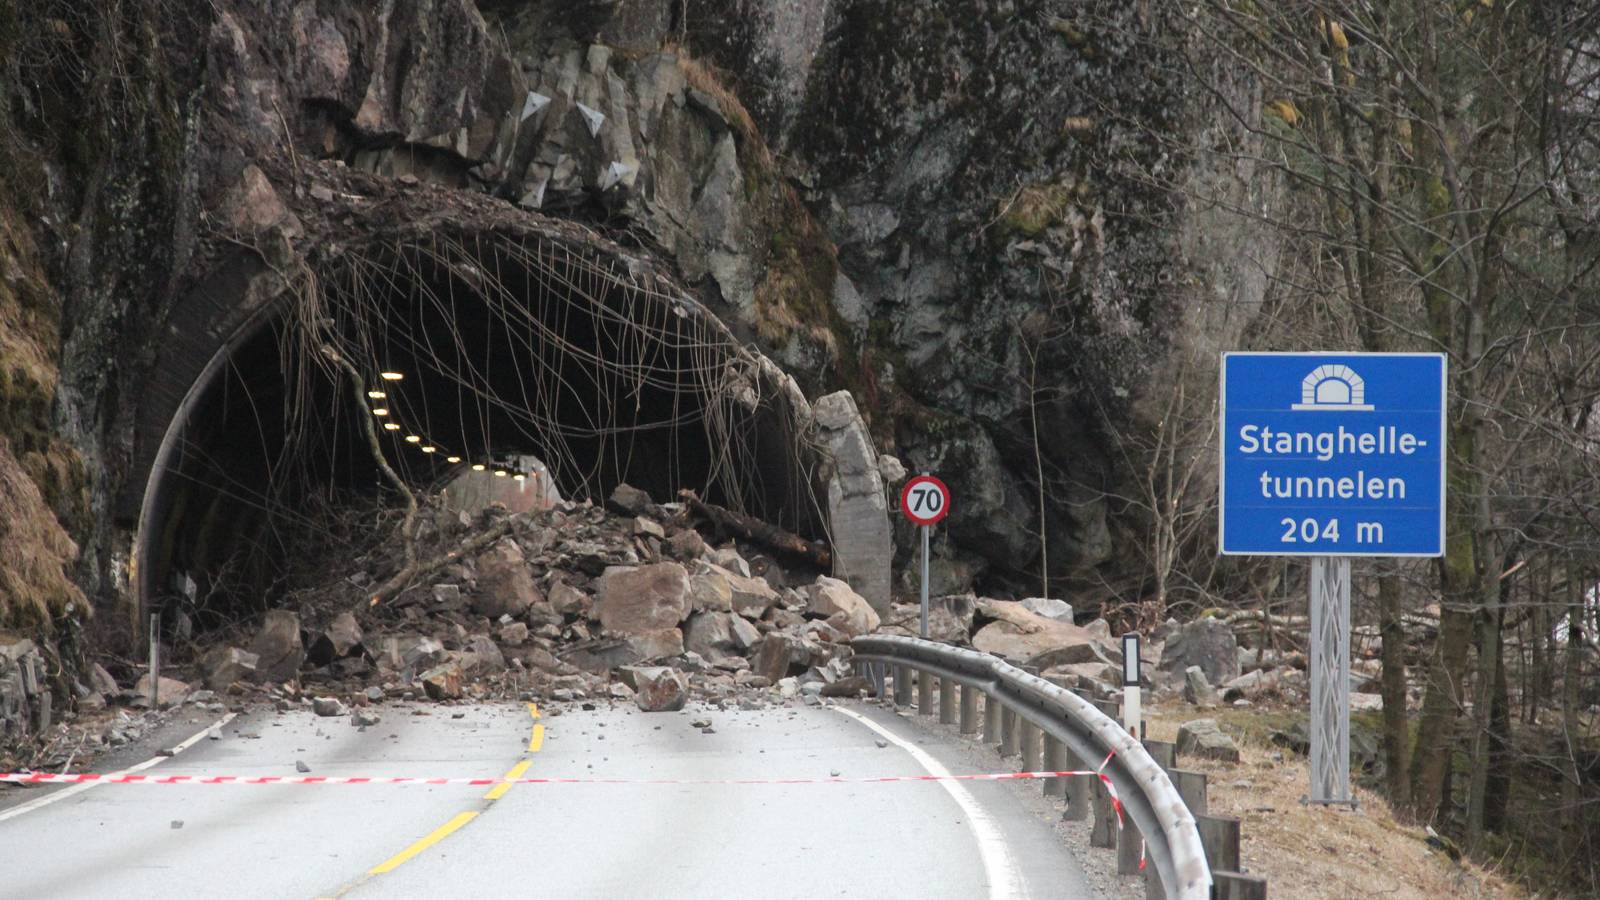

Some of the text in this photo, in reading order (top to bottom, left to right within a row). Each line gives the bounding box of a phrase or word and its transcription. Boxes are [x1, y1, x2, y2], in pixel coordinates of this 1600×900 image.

[1239, 424, 1427, 461] Stanghelle-
[1260, 470, 1405, 499] tunnelen
[912, 489, 942, 513] 70
[1281, 517, 1383, 543] 204 m
